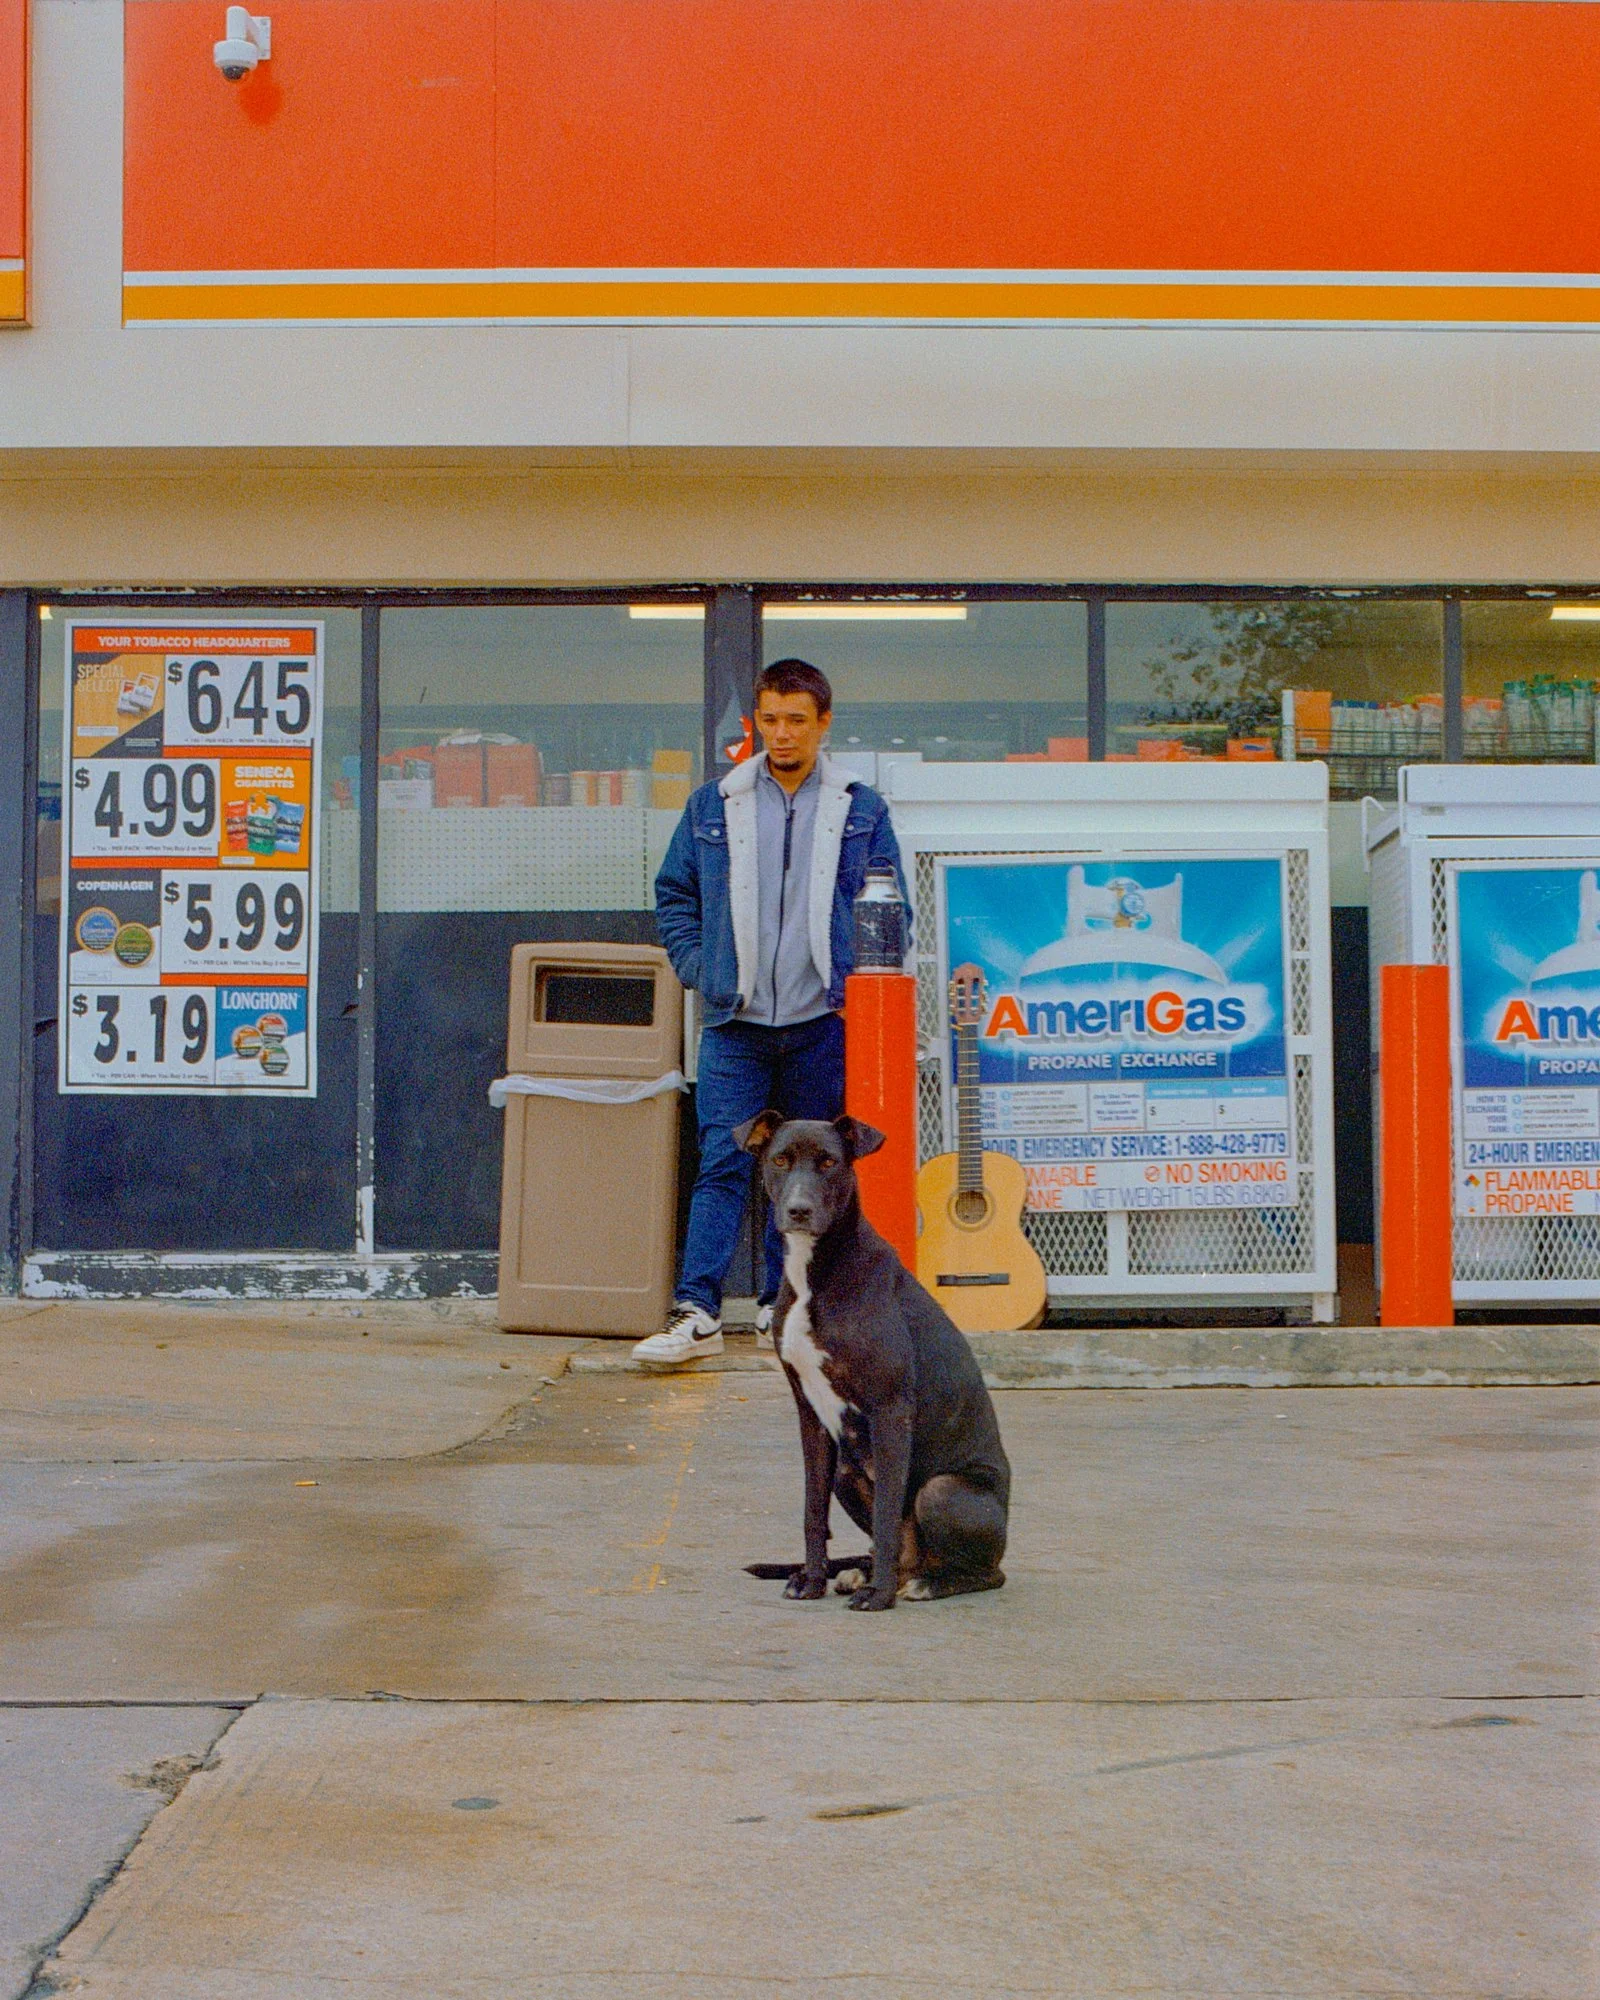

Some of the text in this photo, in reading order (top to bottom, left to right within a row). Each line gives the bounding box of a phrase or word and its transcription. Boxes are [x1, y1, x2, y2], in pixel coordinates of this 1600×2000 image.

[97, 636, 291, 648] YOUR TOBACCO HEADQUARTERS
[77, 664, 125, 679] SPECIAL
[234, 766, 295, 778] SENECA
[234, 779, 295, 789] CIGARETTES
[76, 880, 154, 892] COPENHAGEN
[222, 990, 298, 1010] LONGHORN
[985, 991, 1246, 1037] AmeriGas
[1028, 1053, 1217, 1071] PROPANE EXCHANGE
[1540, 1059, 1600, 1075] PROPA
[1023, 1136, 1105, 1159] EMERGENCY
[1111, 1135, 1172, 1157] SERVICE:
[1174, 1132, 1287, 1155] 1-888-428-9779
[1468, 1143, 1529, 1163] 24-HOUR
[1166, 1161, 1287, 1184] NO SMOKING
[1082, 1188, 1117, 1209] NET
[1120, 1186, 1182, 1208] WEIGHT
[1485, 1193, 1574, 1214] PROPANE
